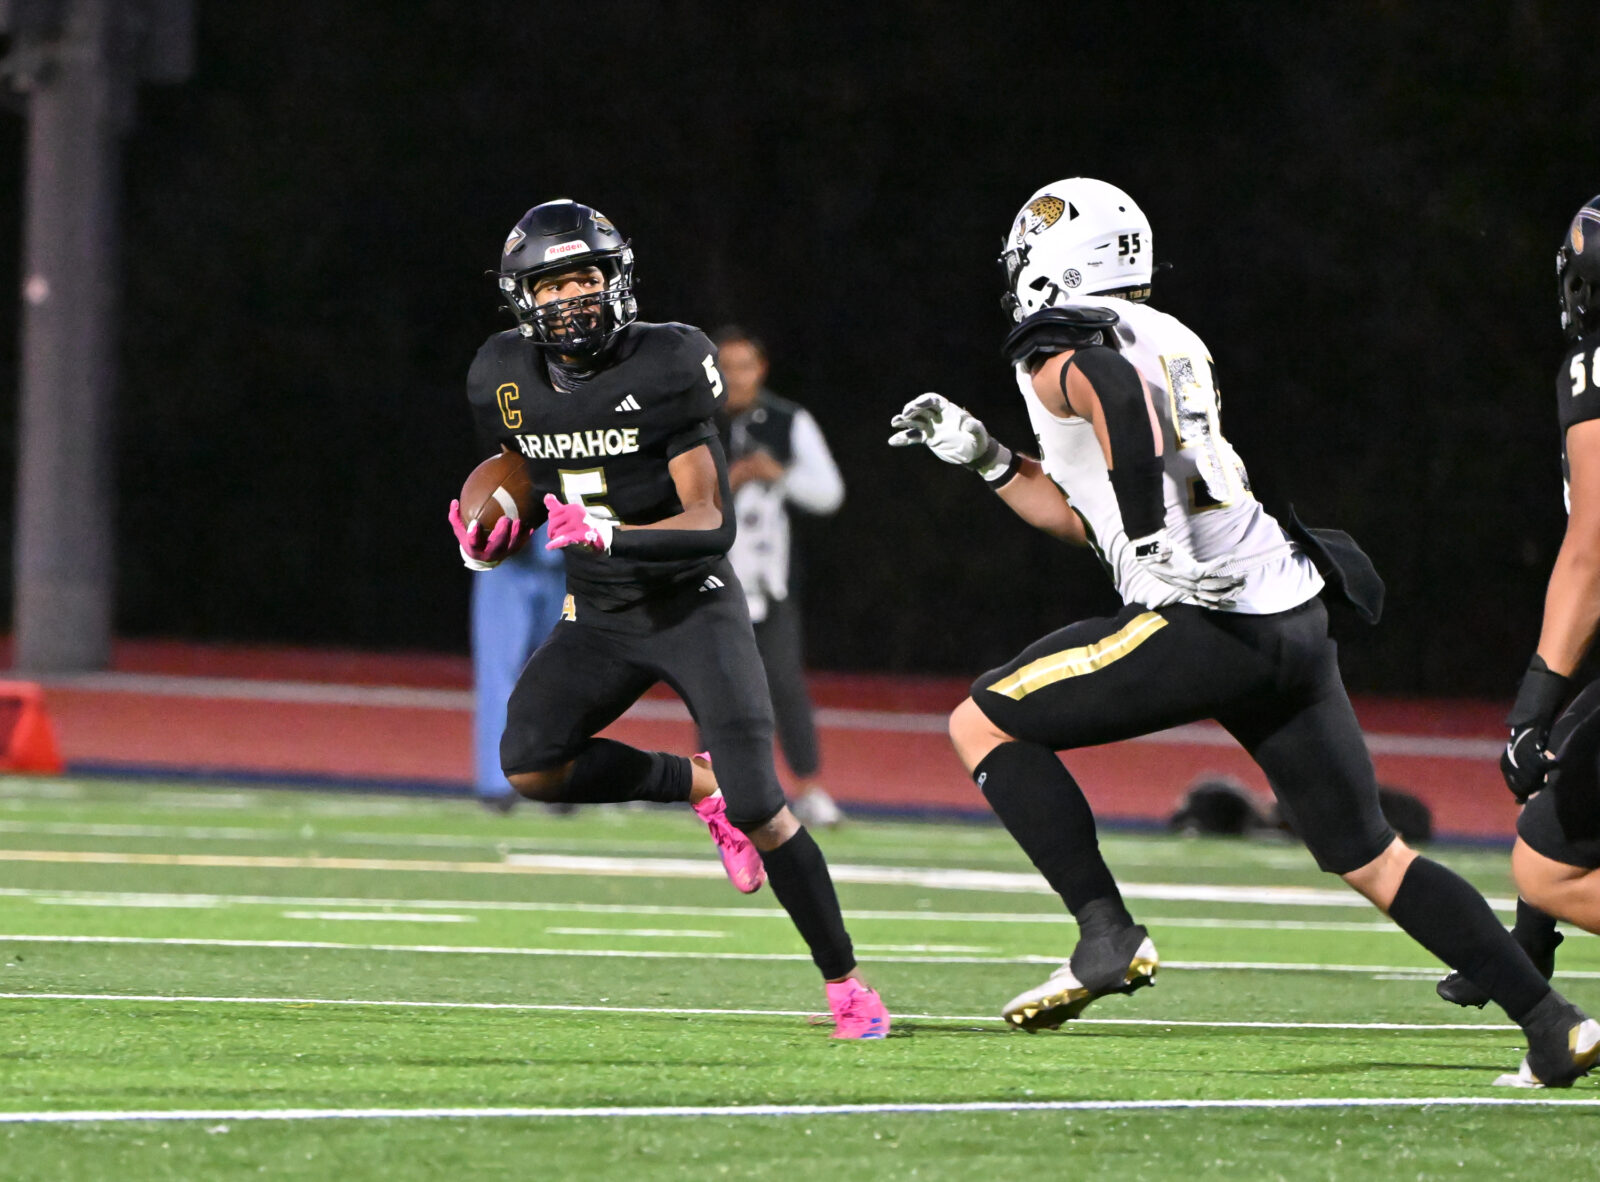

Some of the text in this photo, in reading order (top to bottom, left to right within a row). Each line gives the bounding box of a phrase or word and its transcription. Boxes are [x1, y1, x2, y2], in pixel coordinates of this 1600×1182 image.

[1118, 232, 1141, 256] 55
[702, 353, 724, 399] 5
[496, 382, 523, 429] C
[514, 427, 640, 460] ARAPAHOE
[558, 467, 624, 526] 5
[1135, 540, 1161, 558] NIKE
